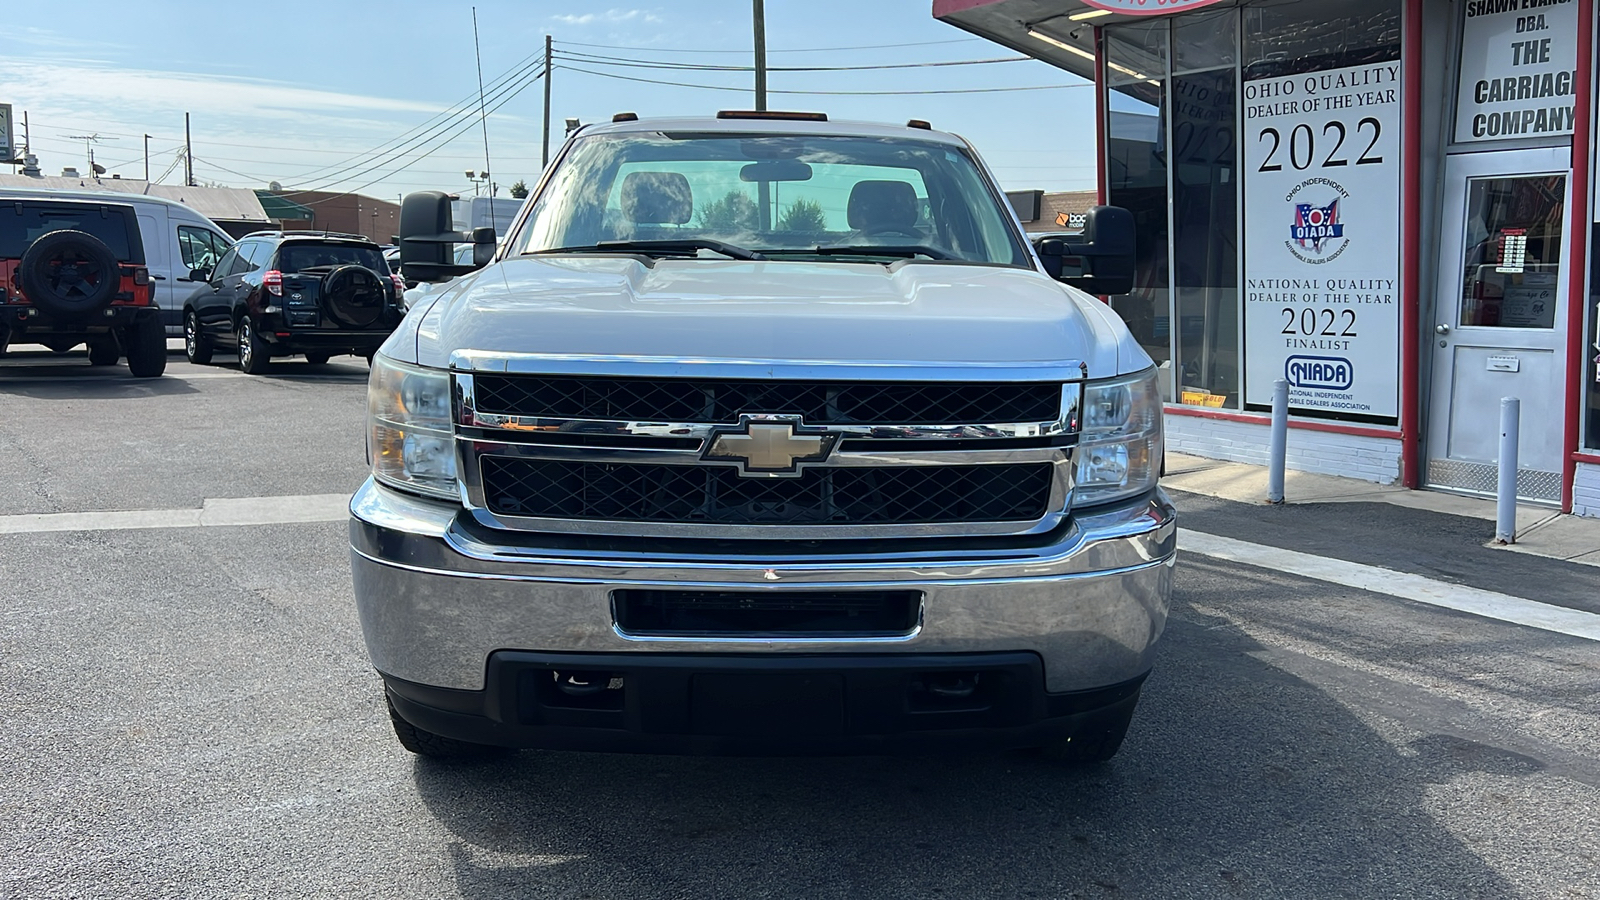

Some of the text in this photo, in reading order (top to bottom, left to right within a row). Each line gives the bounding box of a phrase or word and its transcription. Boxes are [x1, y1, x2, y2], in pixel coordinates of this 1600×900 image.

[1467, 0, 1518, 17] SHAWN
[1516, 14, 1549, 33] DBA.
[1511, 38, 1551, 66] THE
[1245, 80, 1295, 100] OHIO
[1304, 65, 1399, 95] QUALITY
[1247, 101, 1299, 119] DEALER
[1302, 98, 1320, 113] OF
[1323, 94, 1353, 110] THE
[1356, 89, 1396, 107] YEAR
[1472, 106, 1576, 138] COMPANY
[1258, 117, 1383, 172] 2022
[1285, 177, 1350, 202] OHIO INDEPENDENT
[1296, 225, 1335, 238] OIADA
[1284, 240, 1306, 263] AUTOMOBILE
[1326, 238, 1350, 262] ASSOCIATION
[1248, 279, 1394, 291] NATIONAL QUALITY
[1249, 292, 1392, 304] DEALER OF THE YEAR
[1281, 307, 1357, 337] 2022
[1286, 338, 1350, 350] FINALIST
[1290, 362, 1347, 384] NIADA
[1289, 389, 1353, 400] ATIONAL INDEPENDENT
[1306, 399, 1329, 408] DEALERS
[1331, 402, 1370, 411] ASSOCIATION
